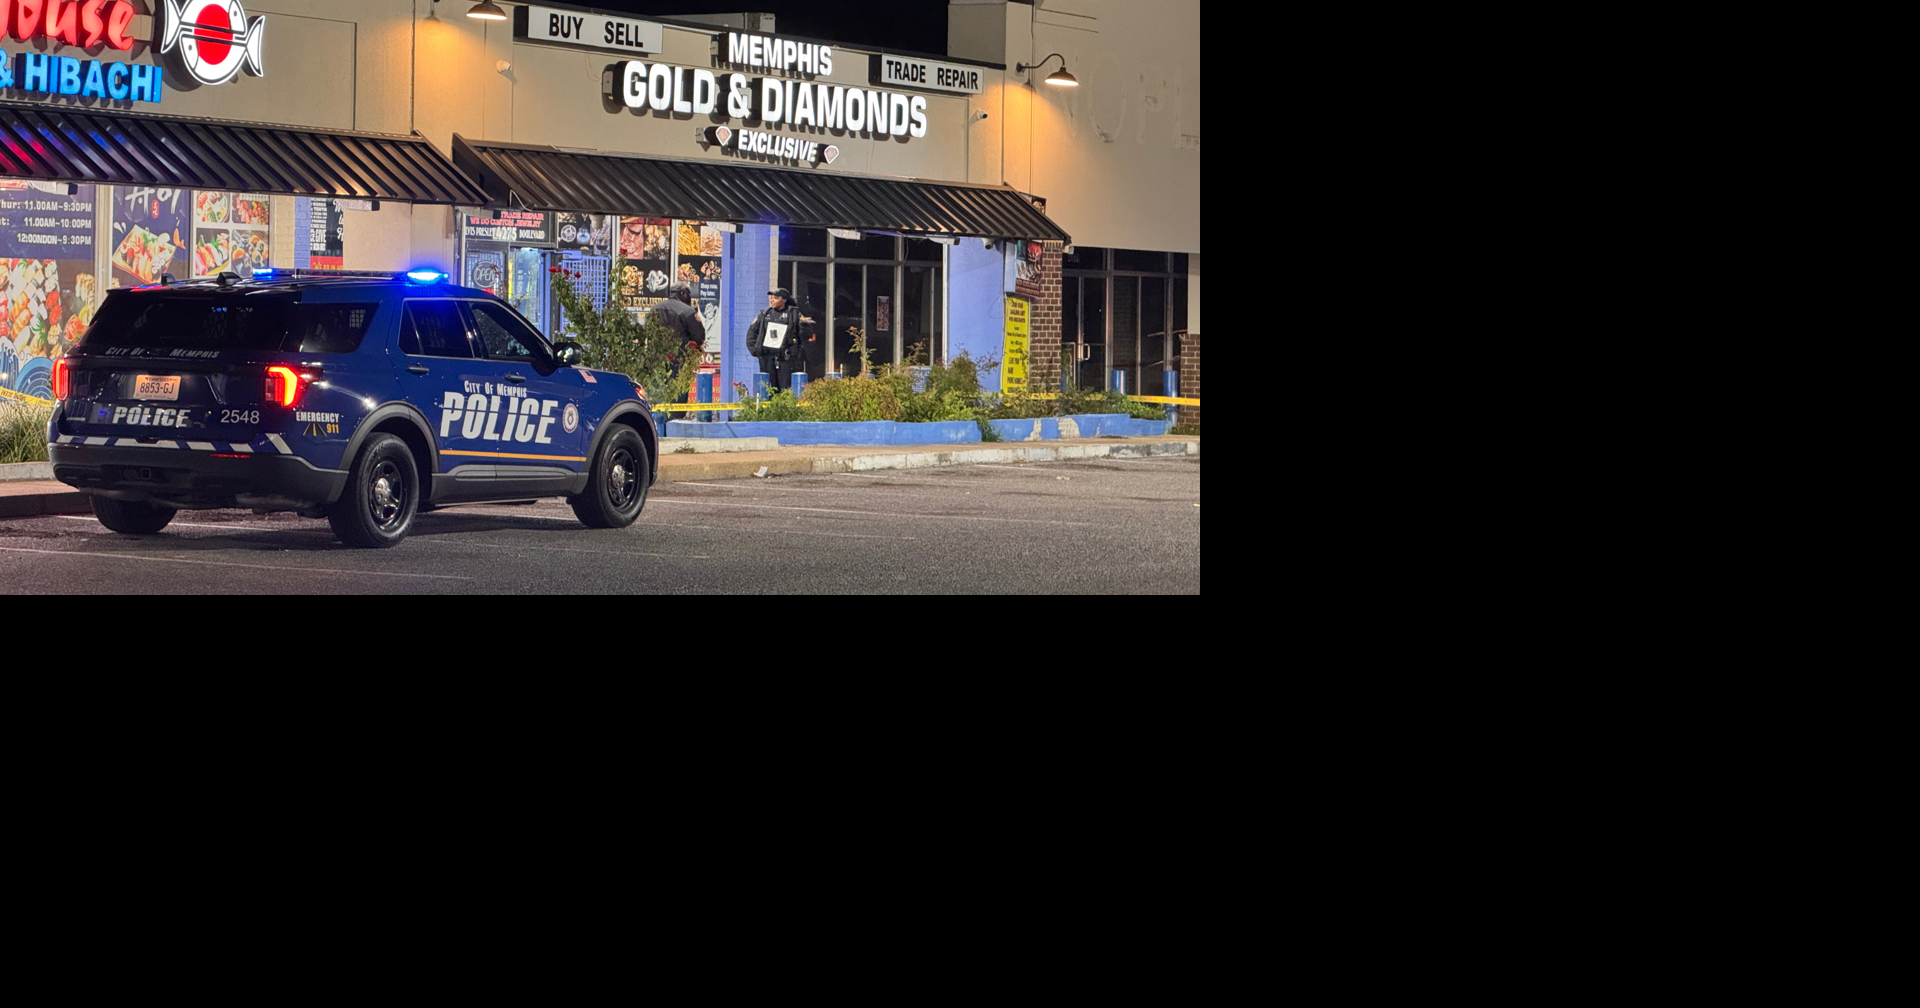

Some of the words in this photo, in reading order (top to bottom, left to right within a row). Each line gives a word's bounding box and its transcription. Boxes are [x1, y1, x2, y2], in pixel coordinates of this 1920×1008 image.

[548, 13, 584, 40] BUY
[603, 20, 644, 48] SELL
[728, 32, 833, 76] MEMPHIS
[24, 52, 163, 103] HIBACHI
[886, 60, 927, 84] TRADE
[937, 67, 979, 90] REPAIR
[622, 60, 716, 115] GOLD
[727, 72, 750, 119] &
[761, 77, 928, 138] DIAMONDS
[738, 128, 818, 163] EXCLUSIVE
[105, 346, 129, 355] CITY
[130, 347, 145, 355] OF
[169, 348, 220, 359] MEMPHIS
[140, 382, 175, 394] 8853-GJ
[464, 380, 481, 393] CITY
[484, 381, 494, 394] OF
[497, 383, 527, 398] MEMPHIS
[112, 406, 191, 427] POLICE
[220, 409, 260, 425] 2548
[295, 411, 340, 423] EMERGENCY
[326, 423, 340, 434] 911
[440, 391, 559, 444] POLICE
